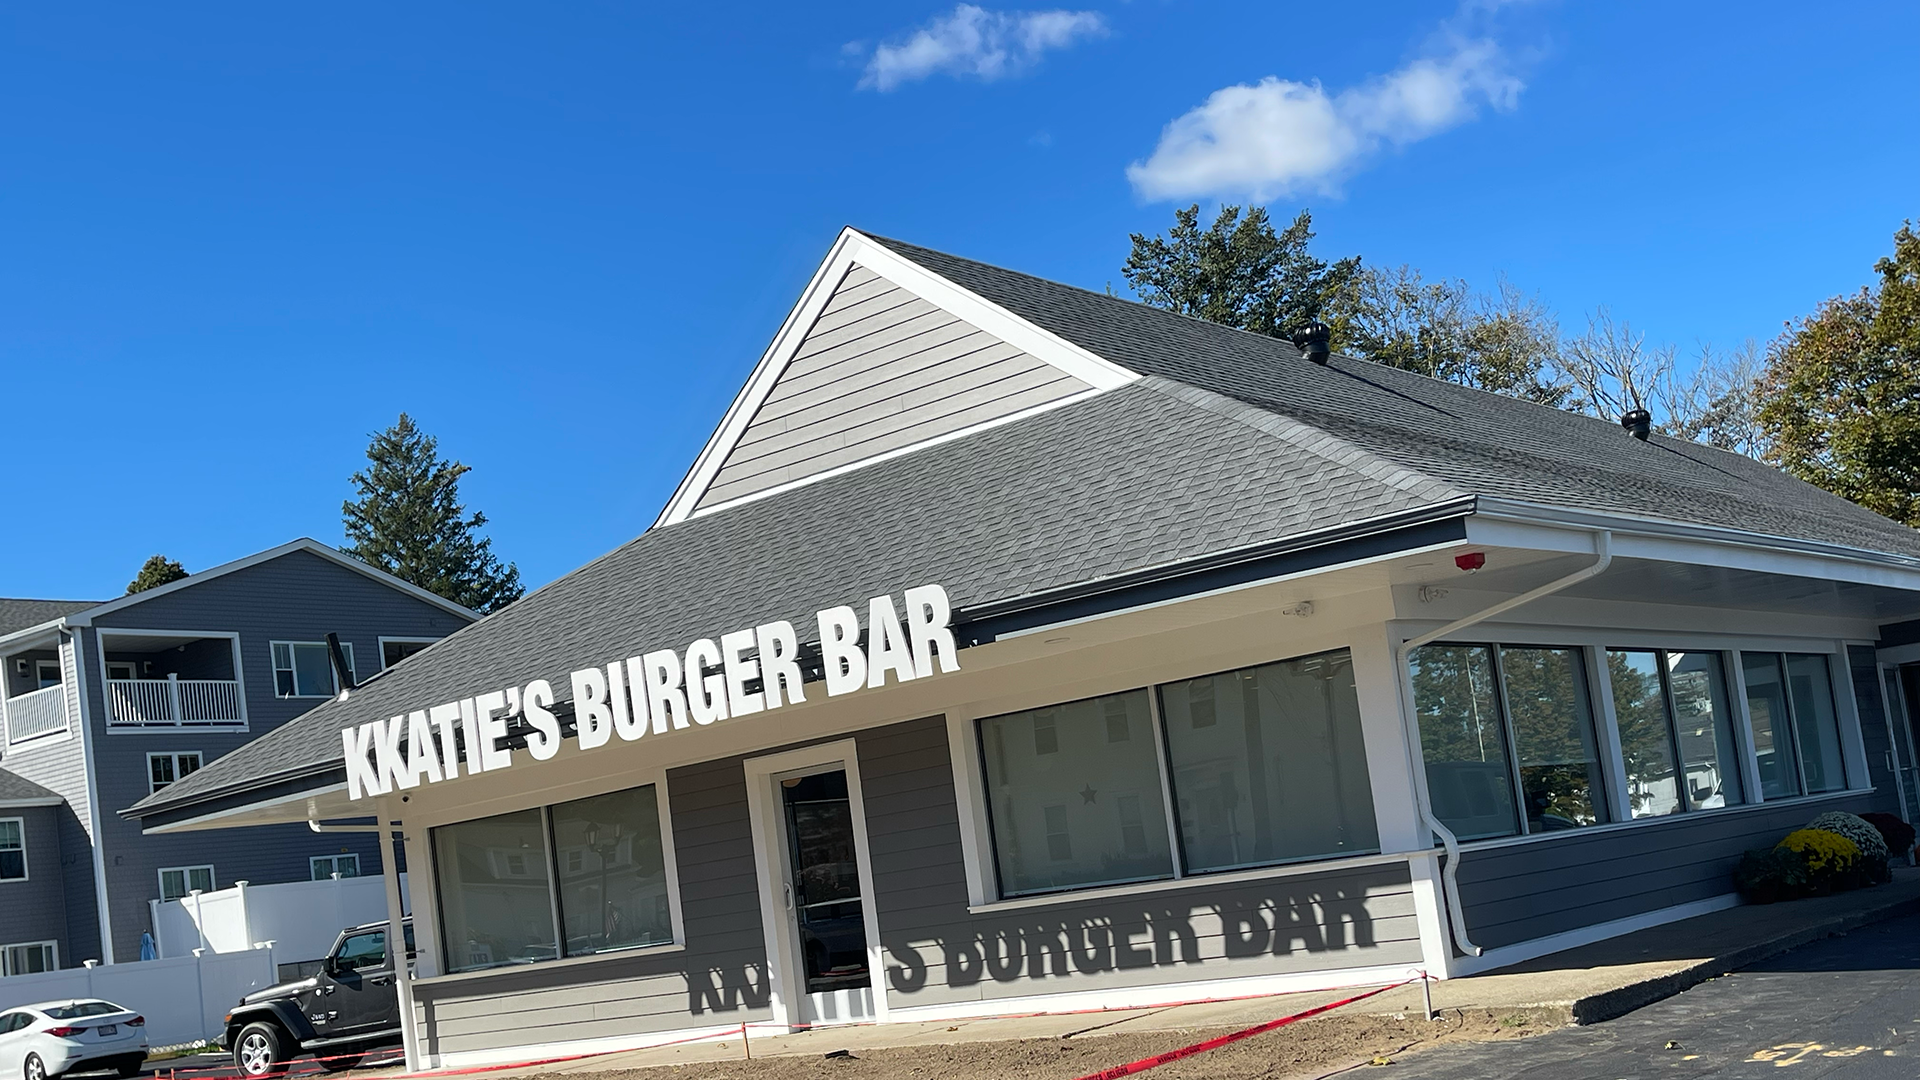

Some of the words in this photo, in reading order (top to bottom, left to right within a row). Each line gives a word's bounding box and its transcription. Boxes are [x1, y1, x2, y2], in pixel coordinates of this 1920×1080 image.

[341, 679, 561, 801] KKATIE'S
[571, 619, 807, 750] BURGER
[817, 584, 961, 697] BAR
